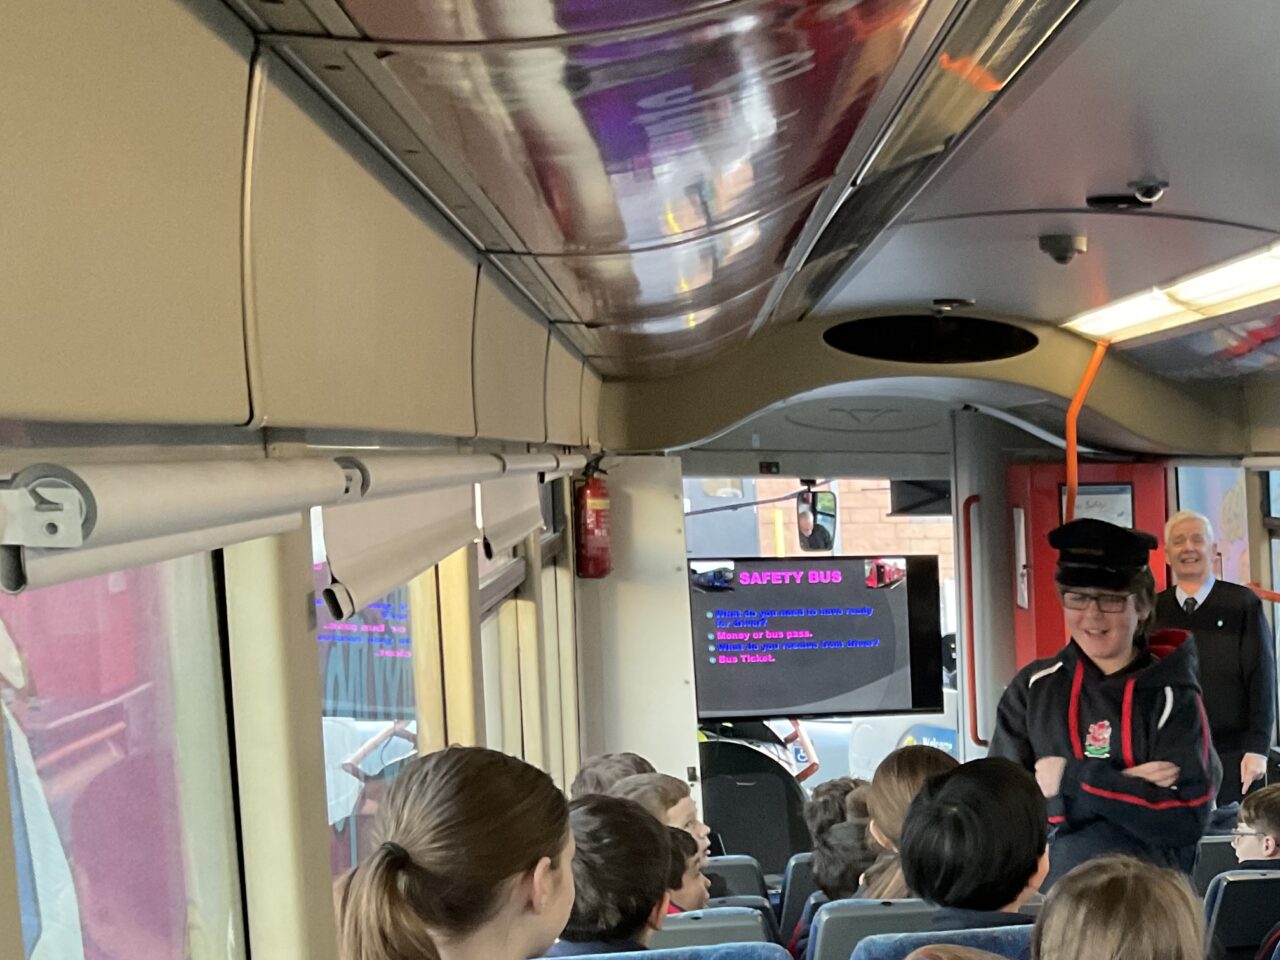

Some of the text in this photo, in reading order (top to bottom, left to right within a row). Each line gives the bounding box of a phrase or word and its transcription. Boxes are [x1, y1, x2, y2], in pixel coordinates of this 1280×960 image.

[739, 570, 843, 585] SAFETY BUS
[758, 609, 778, 619] you
[716, 631, 750, 641] Money
[765, 630, 784, 639] bus
[786, 631, 814, 641] pass.
[760, 642, 780, 652] you
[718, 654, 776, 664] Bus Ticket.
